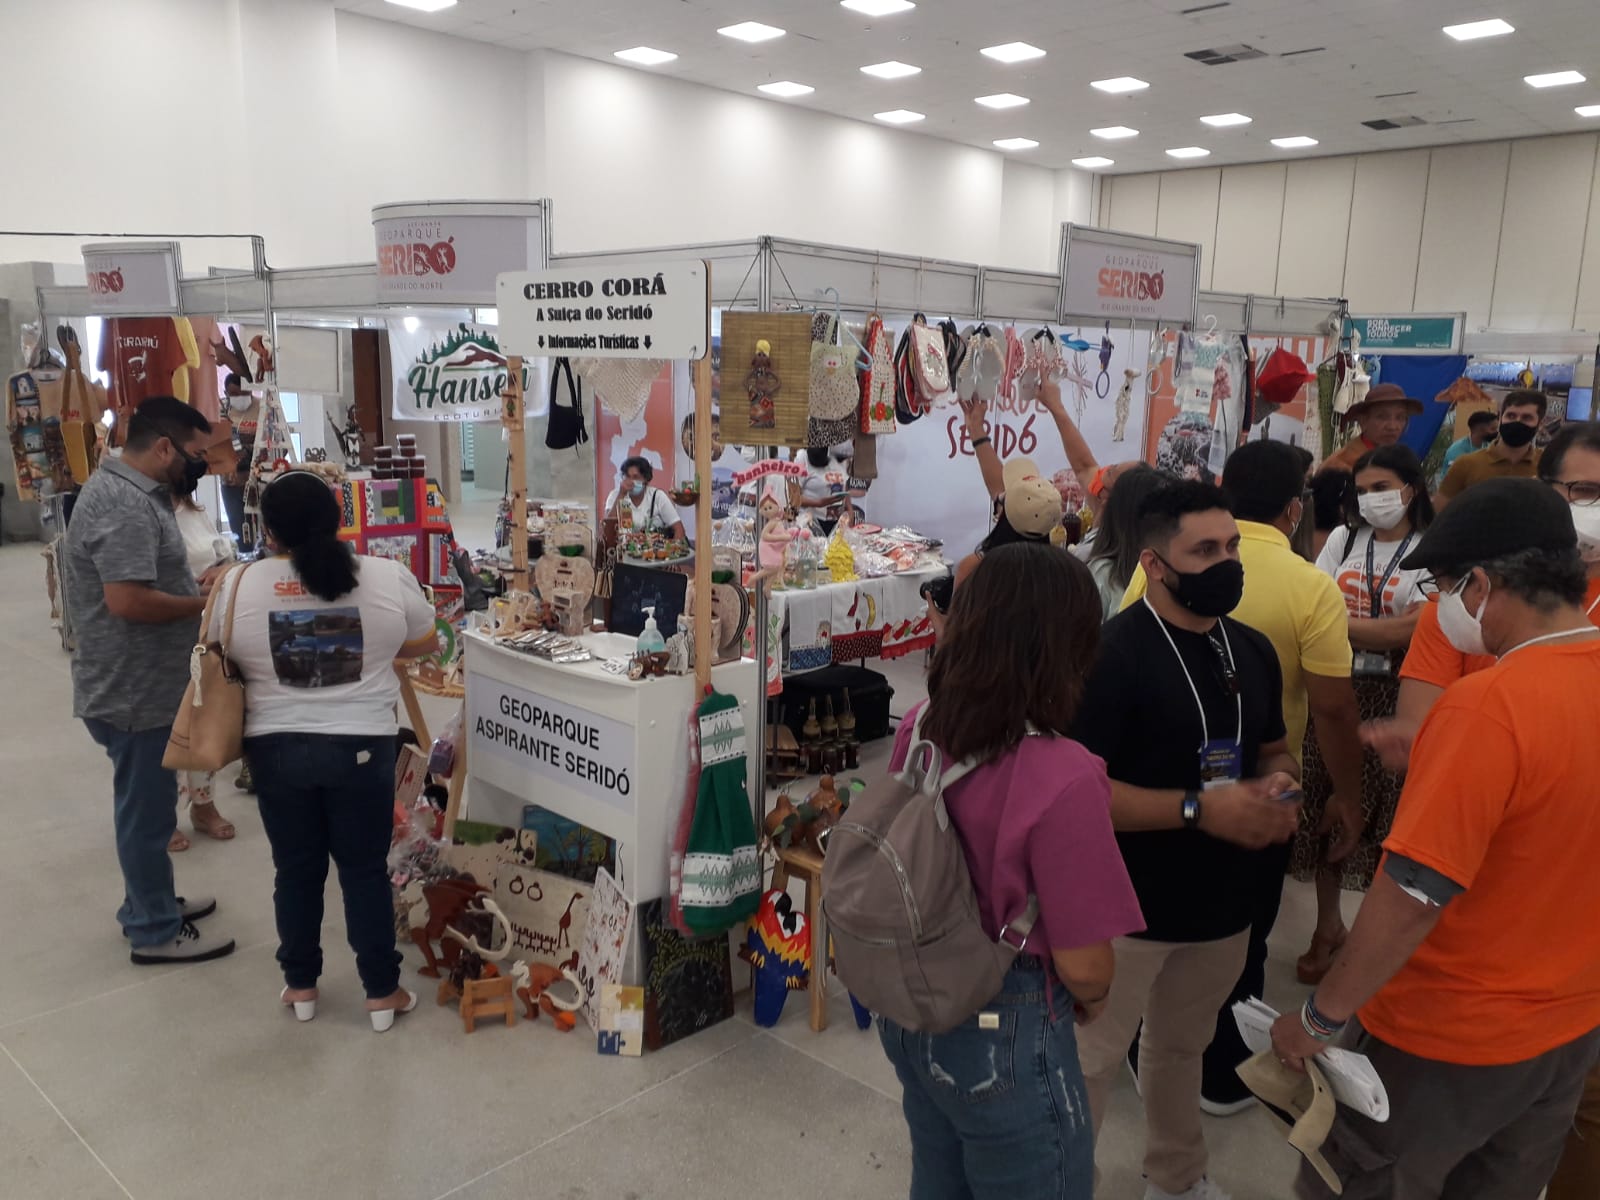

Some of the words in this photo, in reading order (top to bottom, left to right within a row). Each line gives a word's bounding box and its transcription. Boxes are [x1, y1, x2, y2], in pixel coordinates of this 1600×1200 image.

[383, 228, 441, 240] EOPARQUE
[378, 236, 456, 276] ERIDÓ
[523, 280, 594, 300] CERRO
[601, 272, 667, 298] CORÁ
[1097, 267, 1164, 301] SERIDÓ
[536, 307, 544, 322] A
[547, 306, 581, 323] Suiça
[585, 305, 602, 321] do
[606, 303, 653, 321] Seridó
[548, 333, 596, 350] Informações
[598, 333, 639, 350] Turísticas
[500, 694, 600, 751] GEOPARQUE
[476, 716, 560, 767] ASPIRANTE
[565, 750, 630, 796] SERIDÓ
